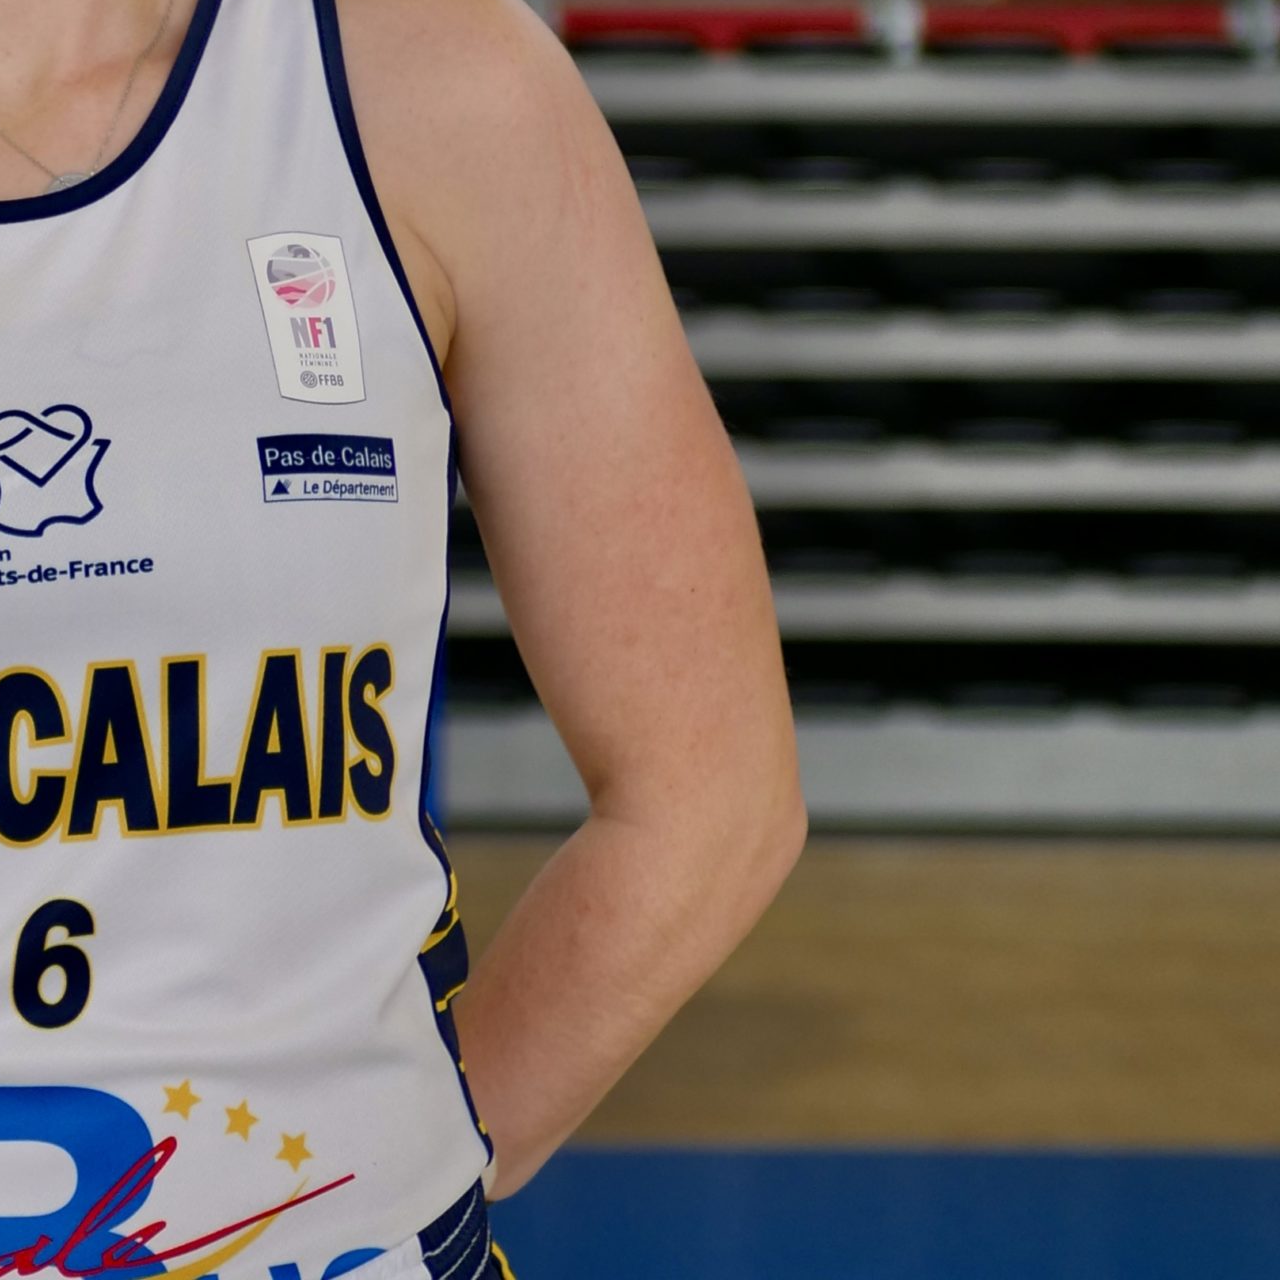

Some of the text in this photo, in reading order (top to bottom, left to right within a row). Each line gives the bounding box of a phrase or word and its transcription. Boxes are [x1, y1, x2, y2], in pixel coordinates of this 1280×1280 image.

[289, 317, 336, 348] NF1
[318, 374, 345, 387] FFBB
[303, 479, 395, 497] Le Département
[11, 898, 96, 1031] 6
